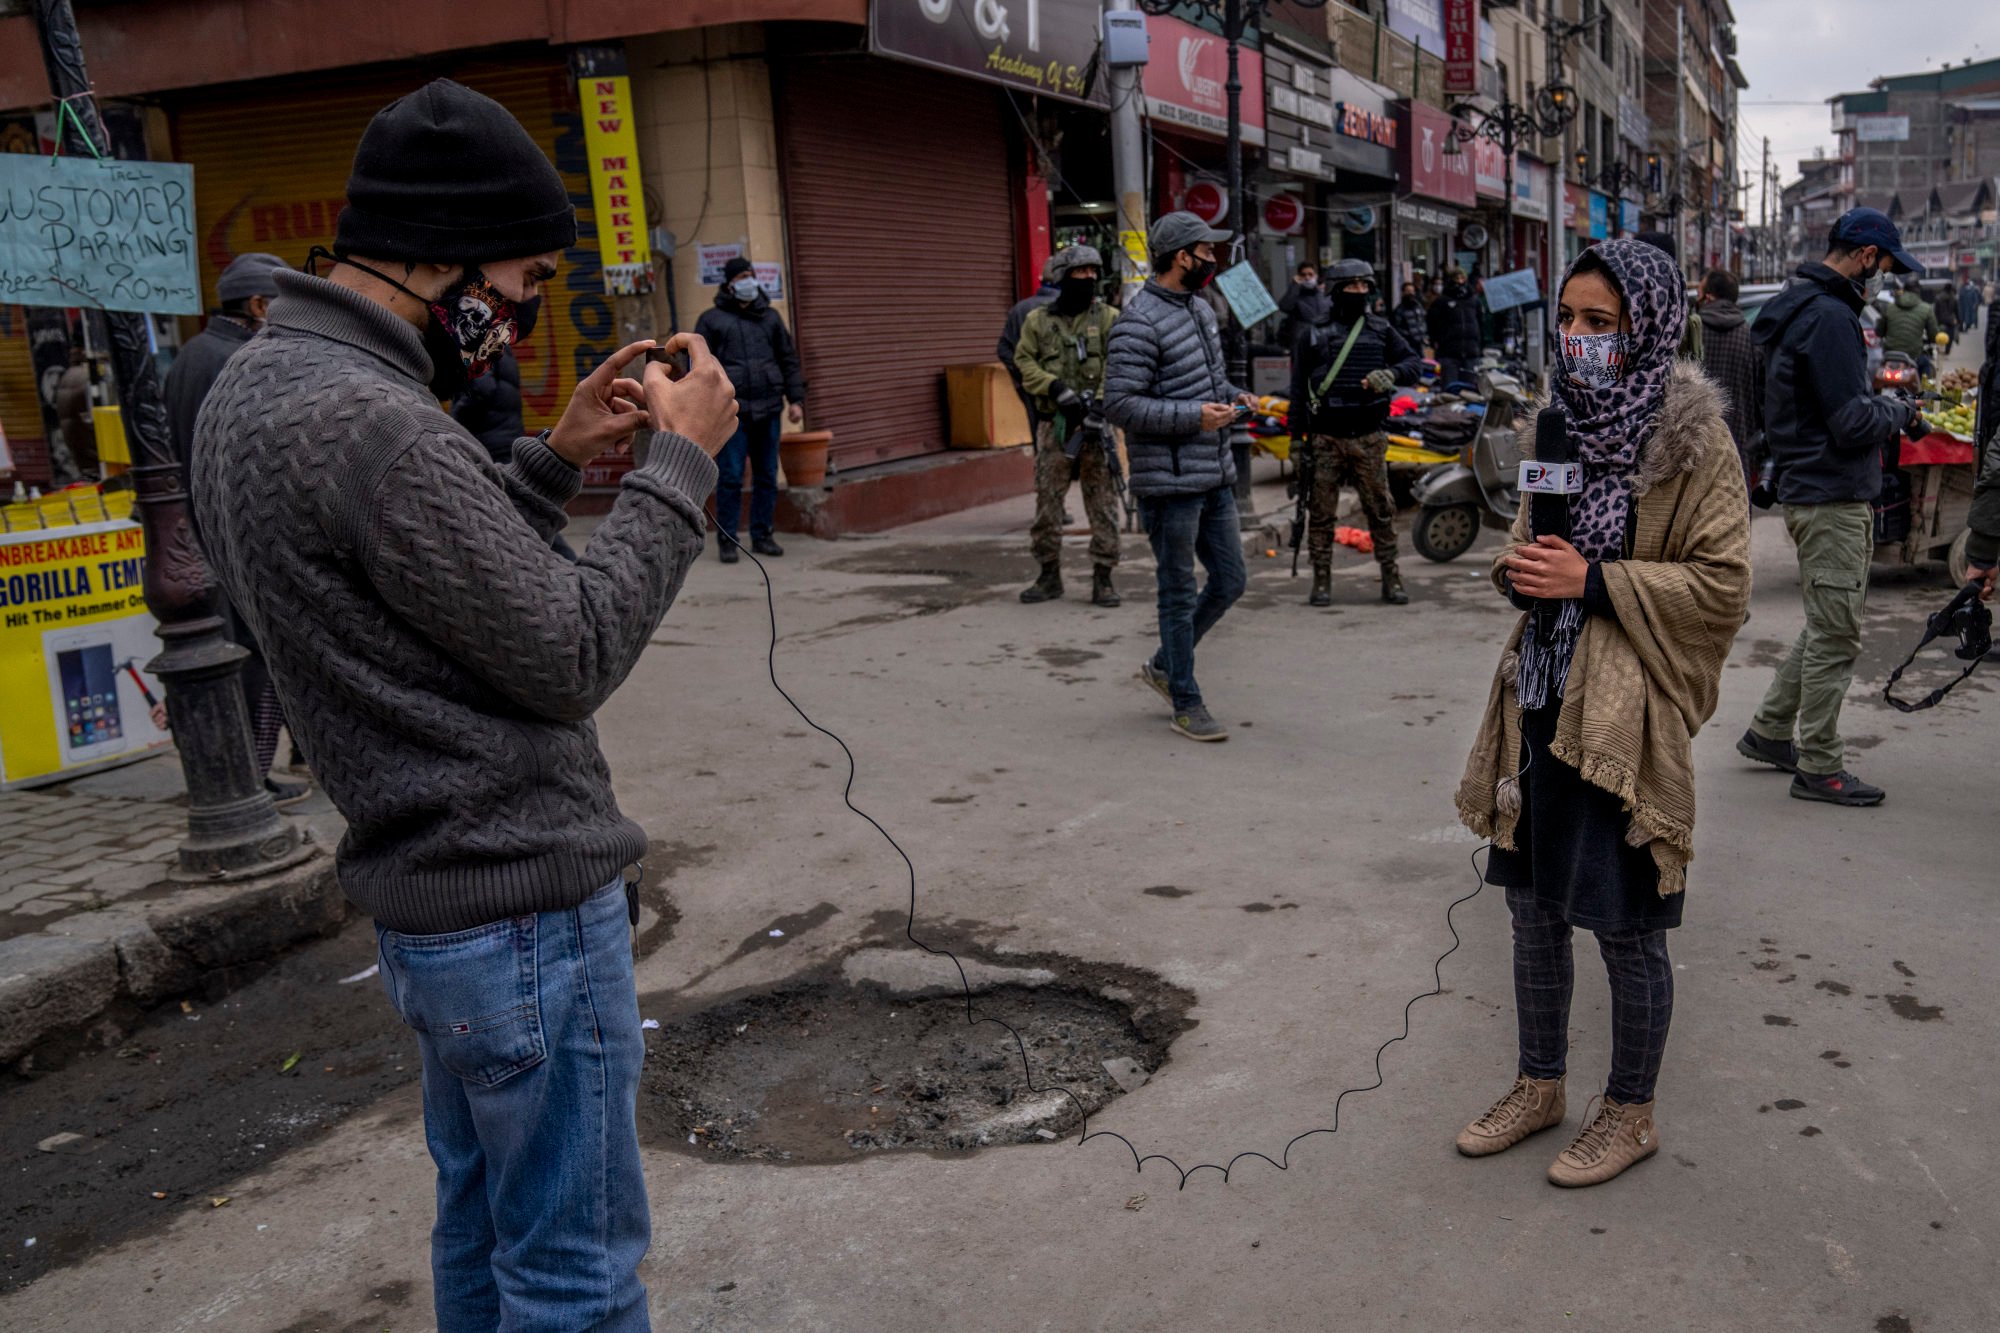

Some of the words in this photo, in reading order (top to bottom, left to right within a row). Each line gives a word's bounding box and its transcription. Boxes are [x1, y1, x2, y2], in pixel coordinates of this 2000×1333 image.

[985, 45, 1043, 86] Academy
[1047, 60, 1062, 93] Of
[1065, 65, 1086, 96] Sty
[594, 82, 623, 133] NEW
[1158, 102, 1177, 119] AZIZ
[1178, 109, 1199, 126] SHOE
[1201, 114, 1229, 132] COLLEC
[1338, 102, 1367, 138] ZERO
[0, 180, 193, 235] USTOMER
[602, 156, 636, 263] MARKET
[40, 222, 189, 271] PARKING
[0, 269, 45, 294] ree
[105, 263, 151, 300] 20
[0, 535, 107, 567] NBREAKABLE
[117, 528, 143, 551] ANT
[0, 566, 91, 607] GORILLA
[6, 612, 28, 627] Hit
[32, 608, 62, 624] The
[67, 599, 125, 618] Hammer
